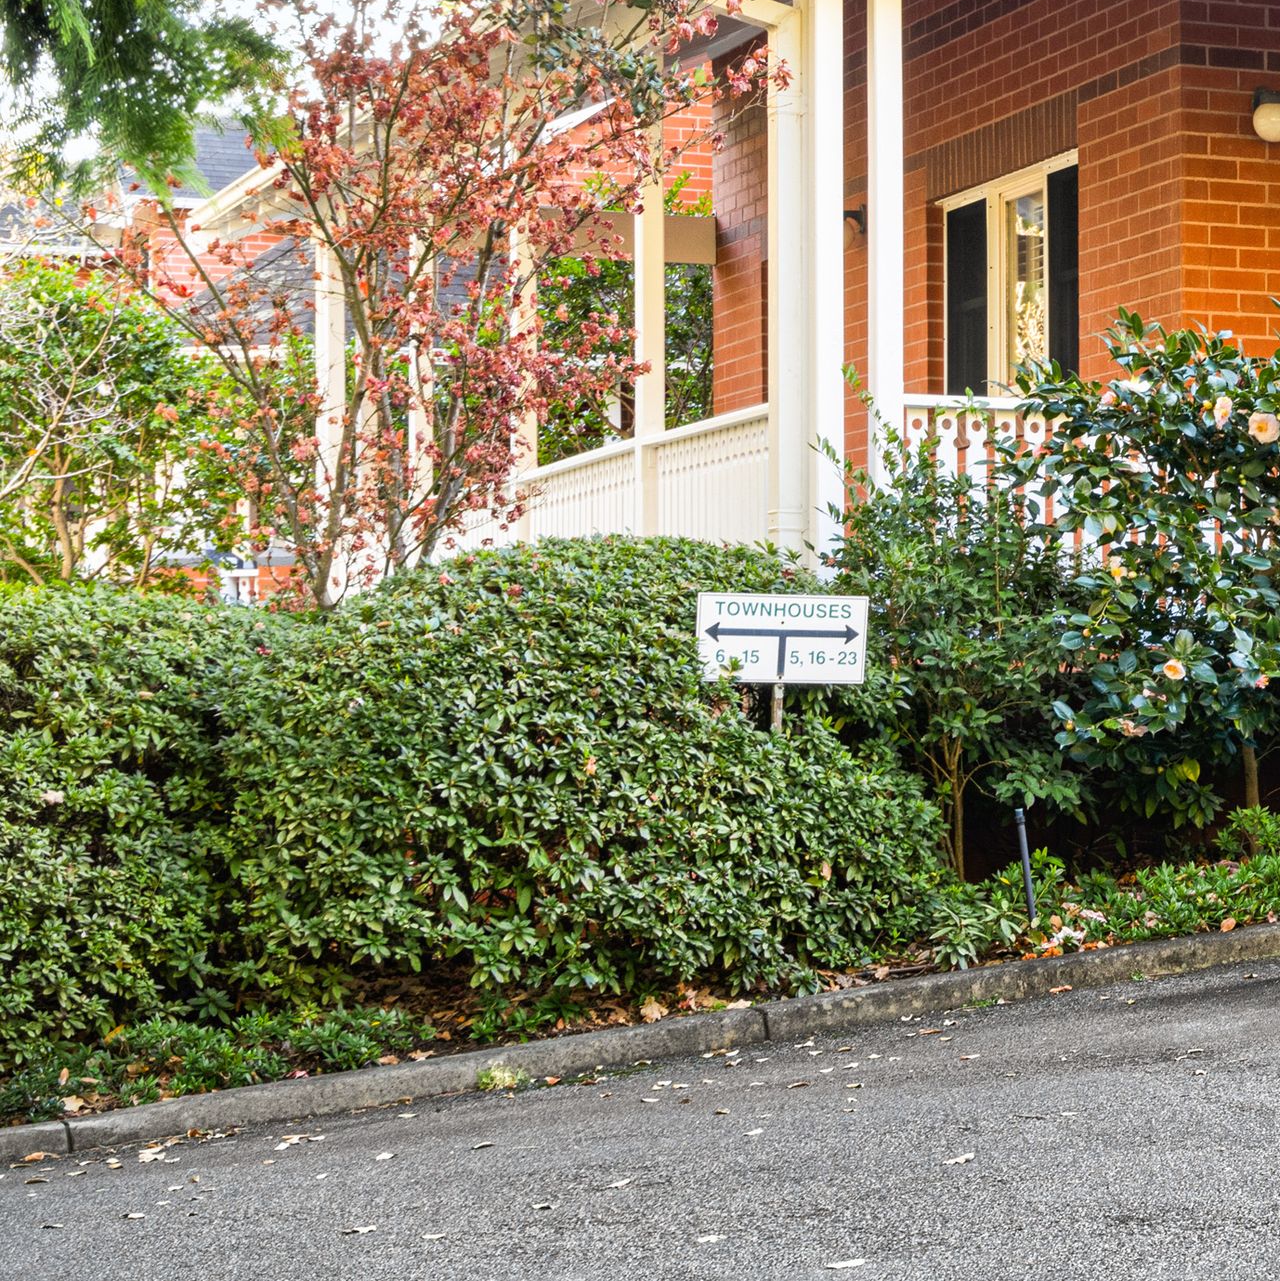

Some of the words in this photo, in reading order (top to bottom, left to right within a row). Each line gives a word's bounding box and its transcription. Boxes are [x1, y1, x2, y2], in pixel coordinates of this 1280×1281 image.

[715, 601, 852, 619] TOWNHOUSES
[715, 649, 725, 663] 6
[743, 650, 760, 664] 15
[790, 651, 803, 667] 5,
